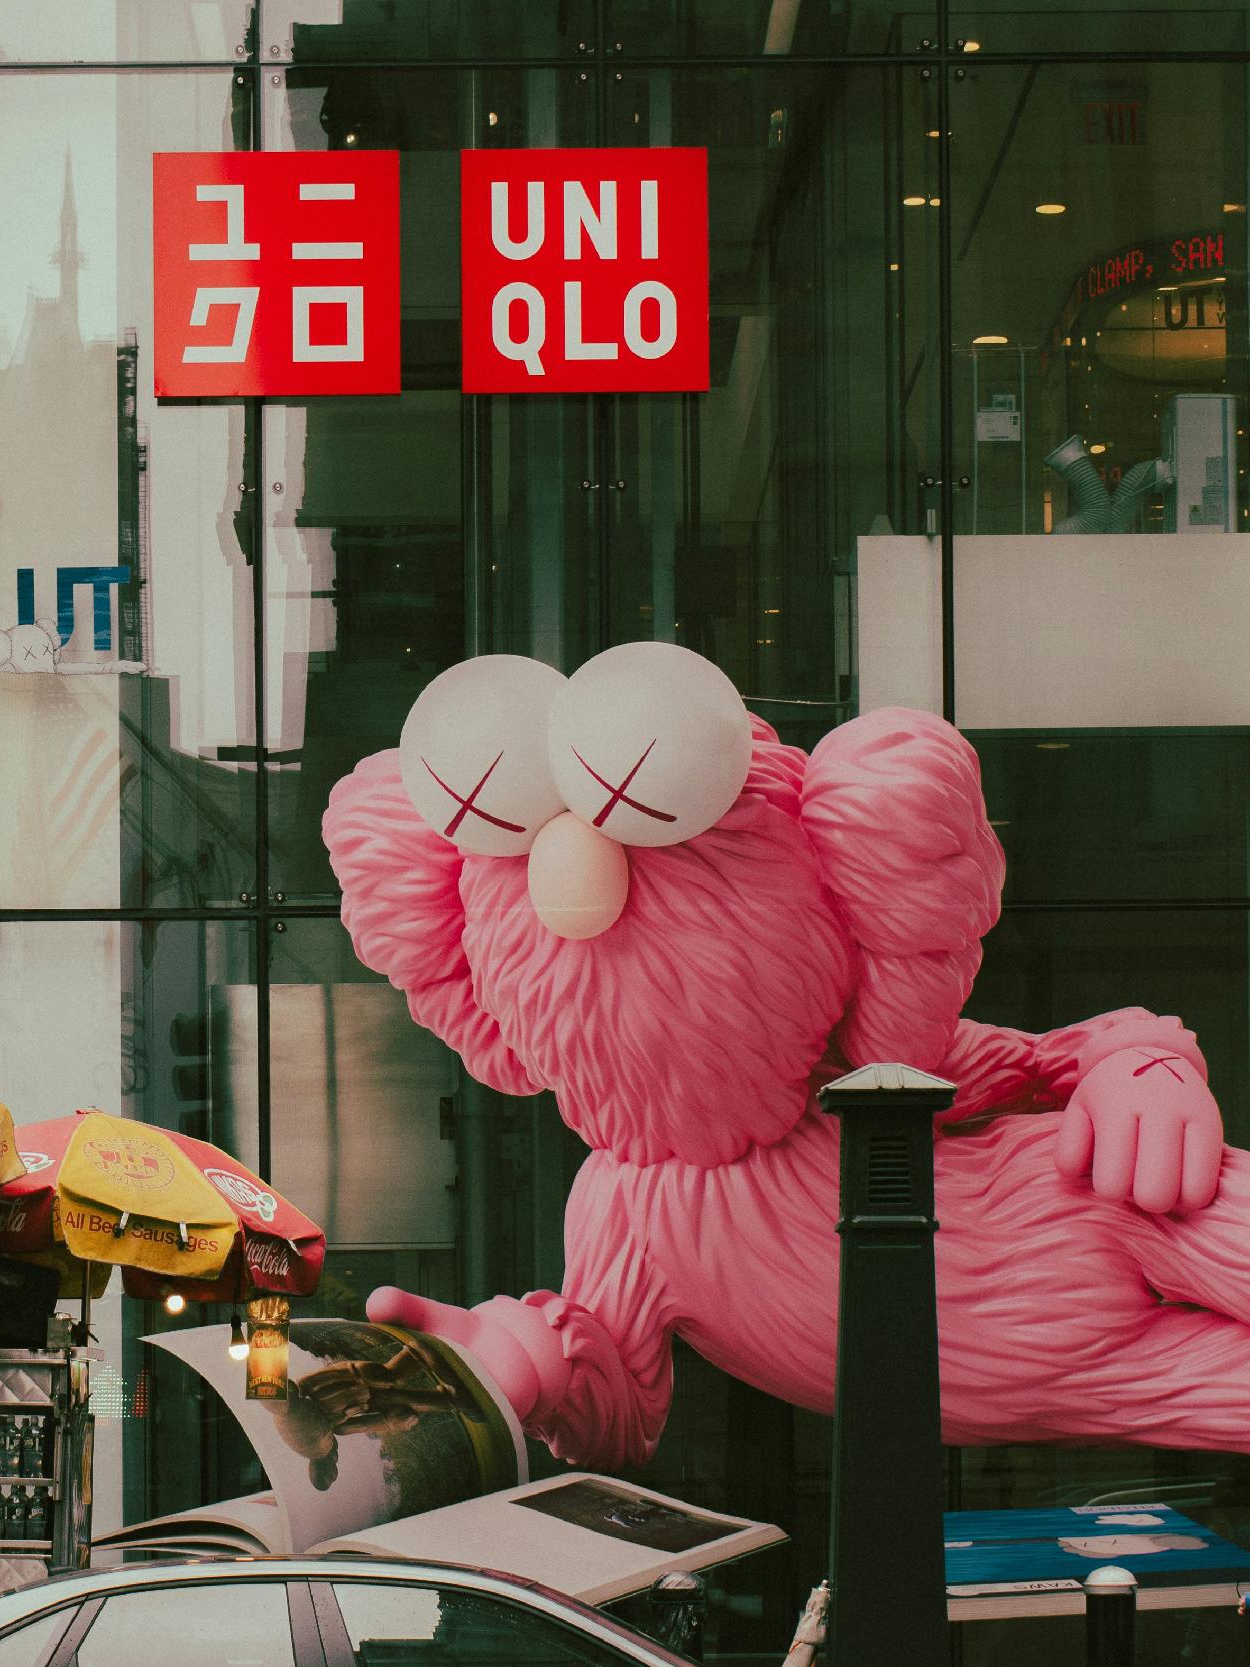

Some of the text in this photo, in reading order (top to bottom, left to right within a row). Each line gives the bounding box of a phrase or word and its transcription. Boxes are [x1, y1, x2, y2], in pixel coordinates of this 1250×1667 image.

[189, 183, 364, 260] ユニ
[491, 179, 659, 260] UNI
[182, 285, 364, 363] クロ
[491, 281, 678, 376] QLO
[65, 1211, 85, 1230] All
[131, 1222, 219, 1253] Sausges
